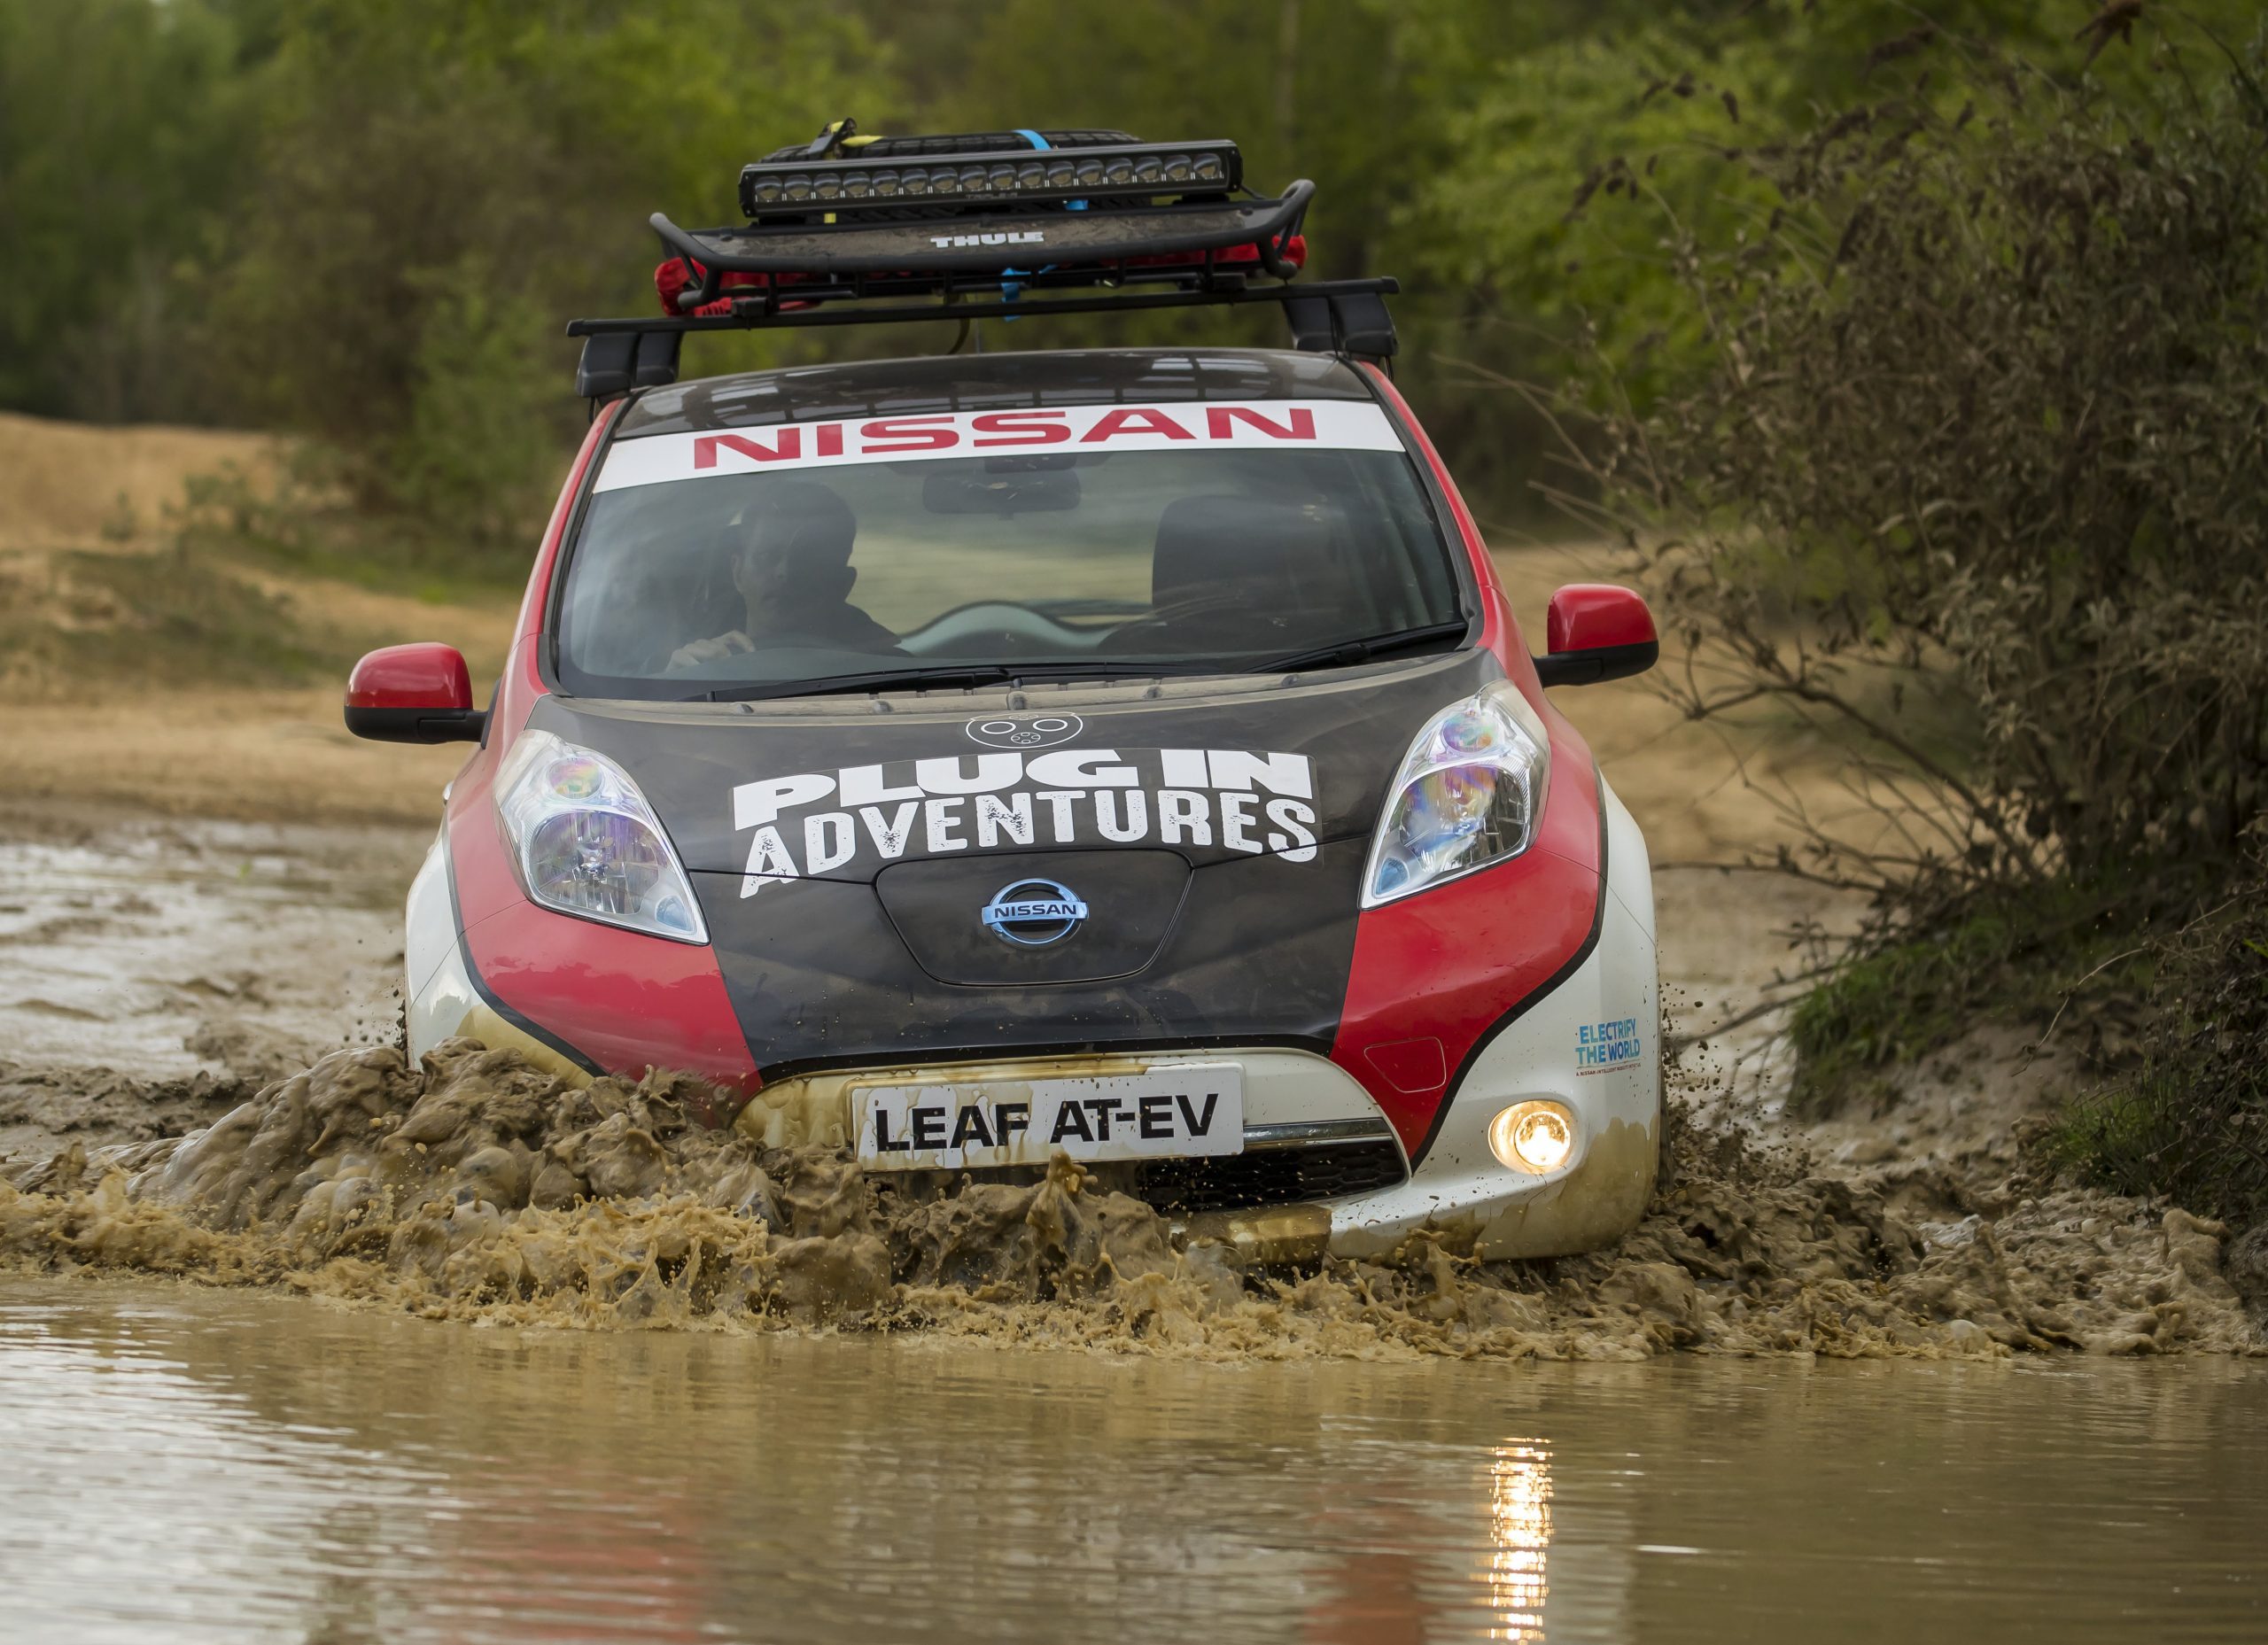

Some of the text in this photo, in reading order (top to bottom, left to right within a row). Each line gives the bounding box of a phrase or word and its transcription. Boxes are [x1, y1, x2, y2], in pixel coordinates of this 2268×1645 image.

[930, 231, 1045, 248] THULE
[693, 407, 1317, 469] NISSAN
[733, 749, 1314, 831] PLUG IN
[739, 789, 1318, 899] ADVENTURES
[994, 904, 1077, 919] NISSAN
[1575, 1038, 1641, 1066] THE WORLD
[1579, 1018, 1636, 1044] ELECTRIFY
[875, 1093, 1219, 1152] LEAF AT-EV
